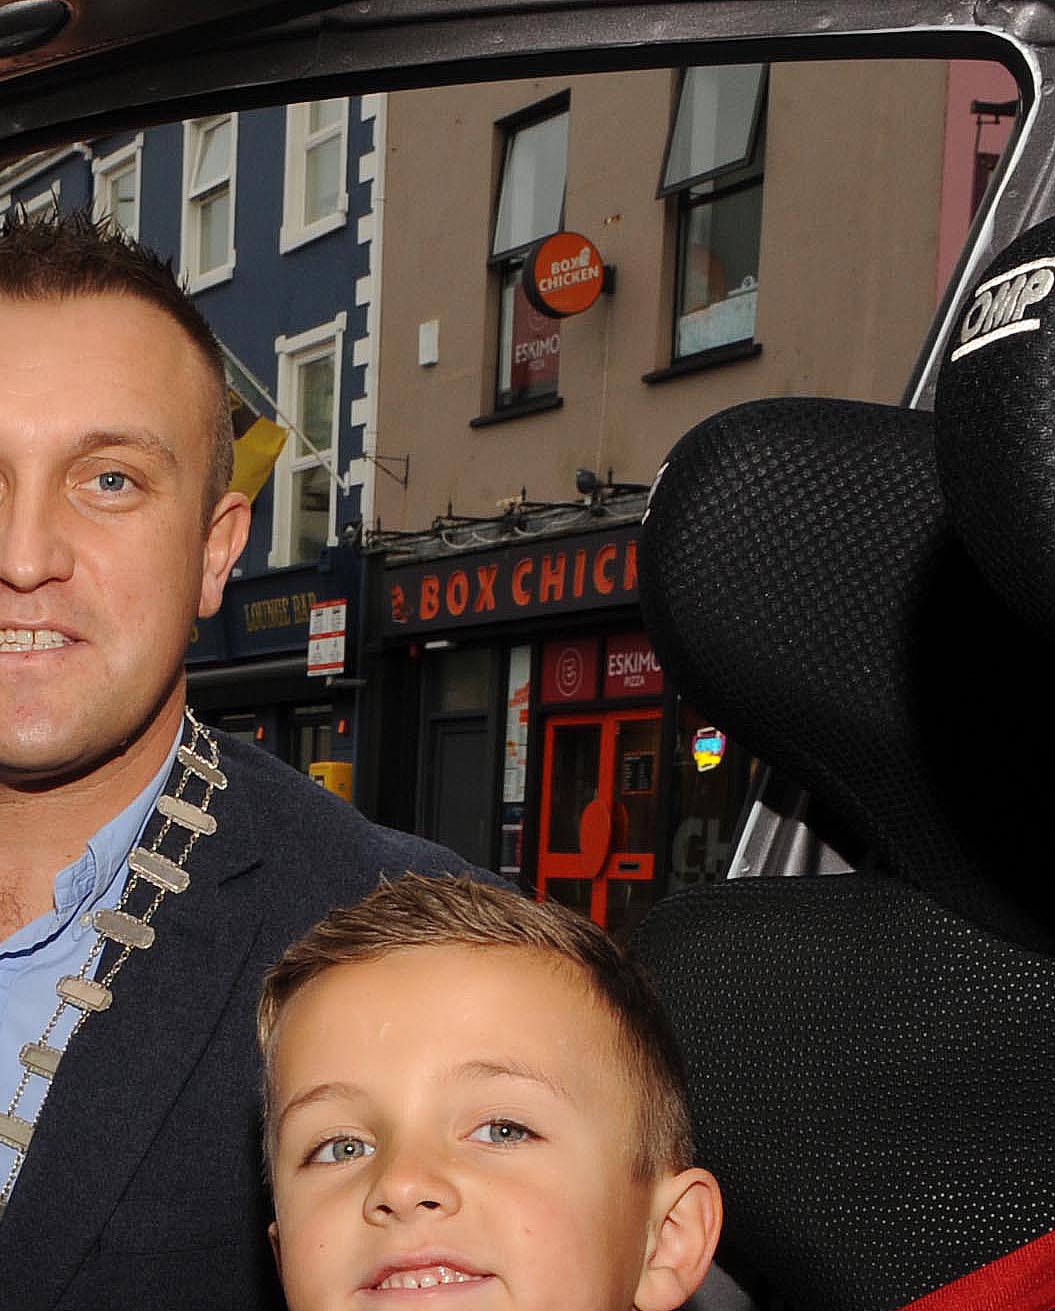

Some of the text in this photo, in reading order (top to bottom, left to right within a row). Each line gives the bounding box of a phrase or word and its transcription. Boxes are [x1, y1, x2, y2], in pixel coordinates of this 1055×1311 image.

[538, 265, 600, 293] CHICKEN
[551, 256, 581, 274] BOX
[960, 268, 1055, 343] OMP
[515, 333, 561, 364] ESKIMO
[419, 563, 499, 621] BOX
[623, 675, 646, 689] PIZZA
